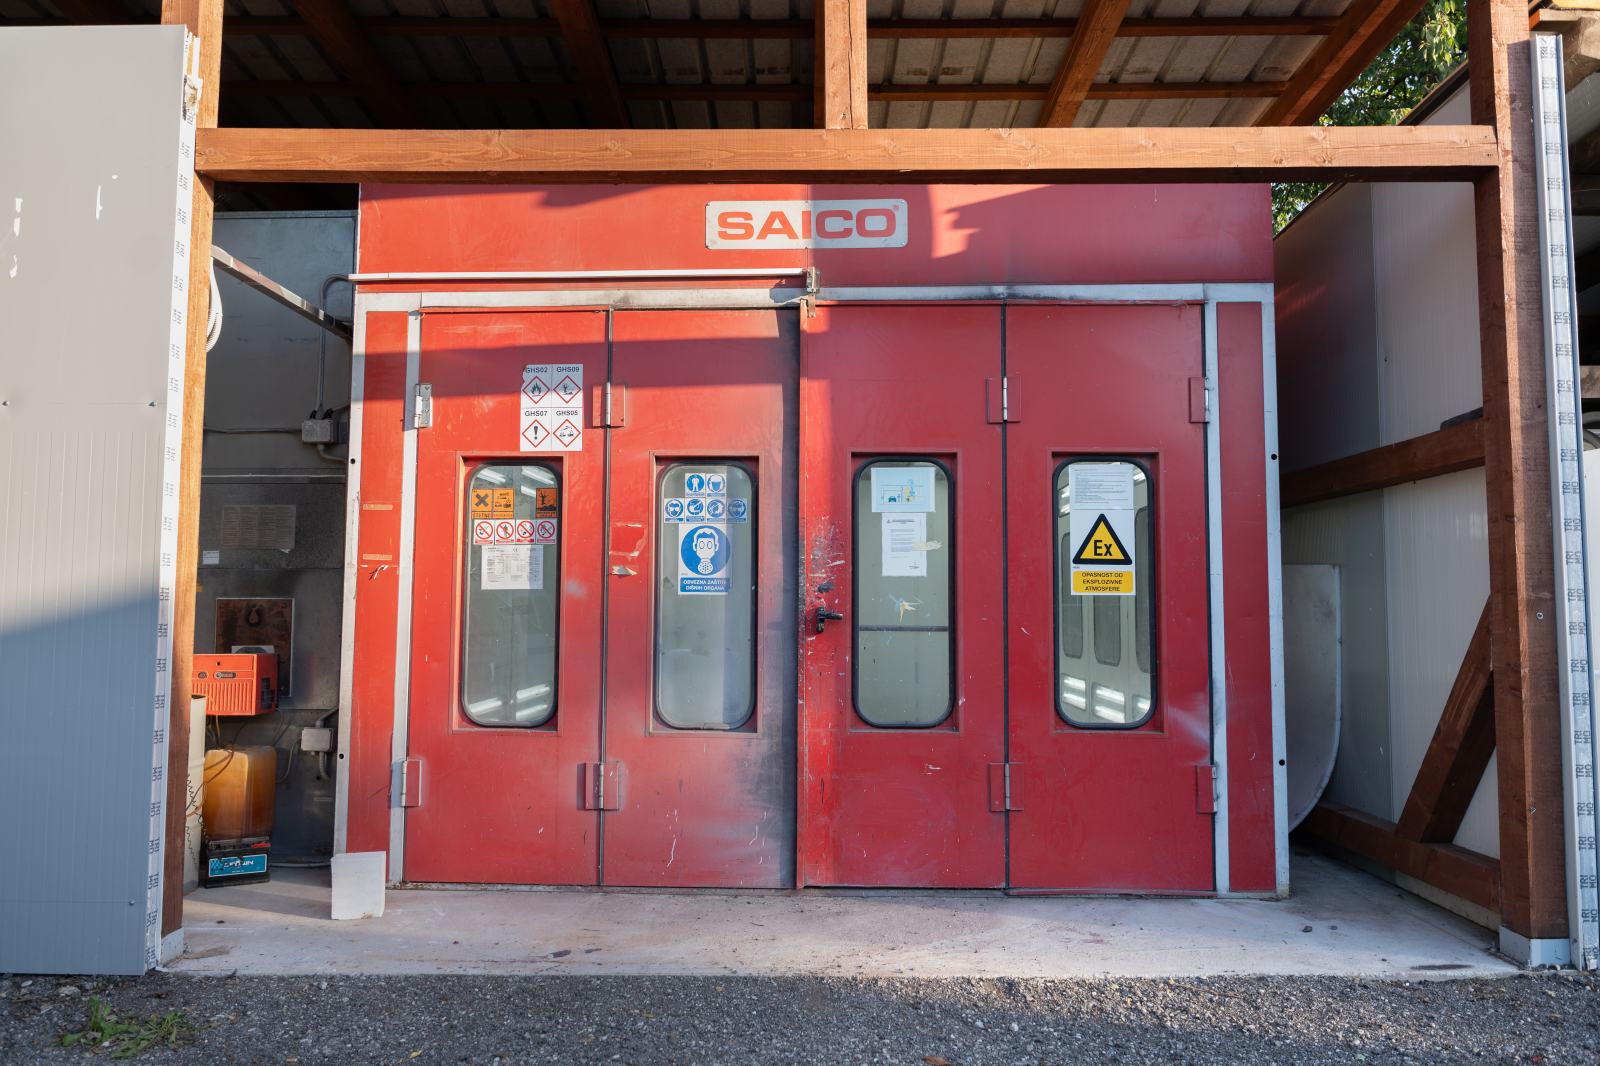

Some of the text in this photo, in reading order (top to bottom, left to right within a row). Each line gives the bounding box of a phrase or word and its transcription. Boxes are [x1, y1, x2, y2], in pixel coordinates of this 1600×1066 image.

[1549, 208, 1557, 220] TRI
[718, 208, 896, 240] SAICO
[1550, 244, 1559, 256] TRI
[1552, 275, 1560, 288] TRI
[1554, 311, 1562, 325] TRI
[1555, 344, 1564, 356] TRI
[1557, 379, 1565, 392] TRI
[1558, 412, 1567, 425] TRI
[1560, 449, 1569, 462] TRI
[1562, 481, 1570, 495] TRI
[1564, 518, 1572, 531] TRI
[1094, 540, 1112, 556] Ex
[1565, 551, 1573, 564] TRI
[1567, 588, 1575, 602] TRI
[1568, 621, 1577, 635] TRI
[1570, 659, 1579, 672] TRI
[1579, 659, 1587, 672] MO
[1571, 692, 1580, 706] TRI
[1581, 692, 1589, 705] MO
[1573, 730, 1582, 744] TRI
[1582, 730, 1590, 743] MO
[1575, 764, 1584, 778] TRI
[1584, 764, 1592, 777] MO
[1577, 802, 1585, 815] TRI
[1586, 802, 1594, 814] MO
[1578, 836, 1586, 849] TRI
[1587, 836, 1594, 848] MO
[1580, 875, 1588, 889] TRI
[1589, 875, 1596, 888] MO
[1581, 909, 1590, 922] TRI
[1590, 909, 1598, 921] MO
